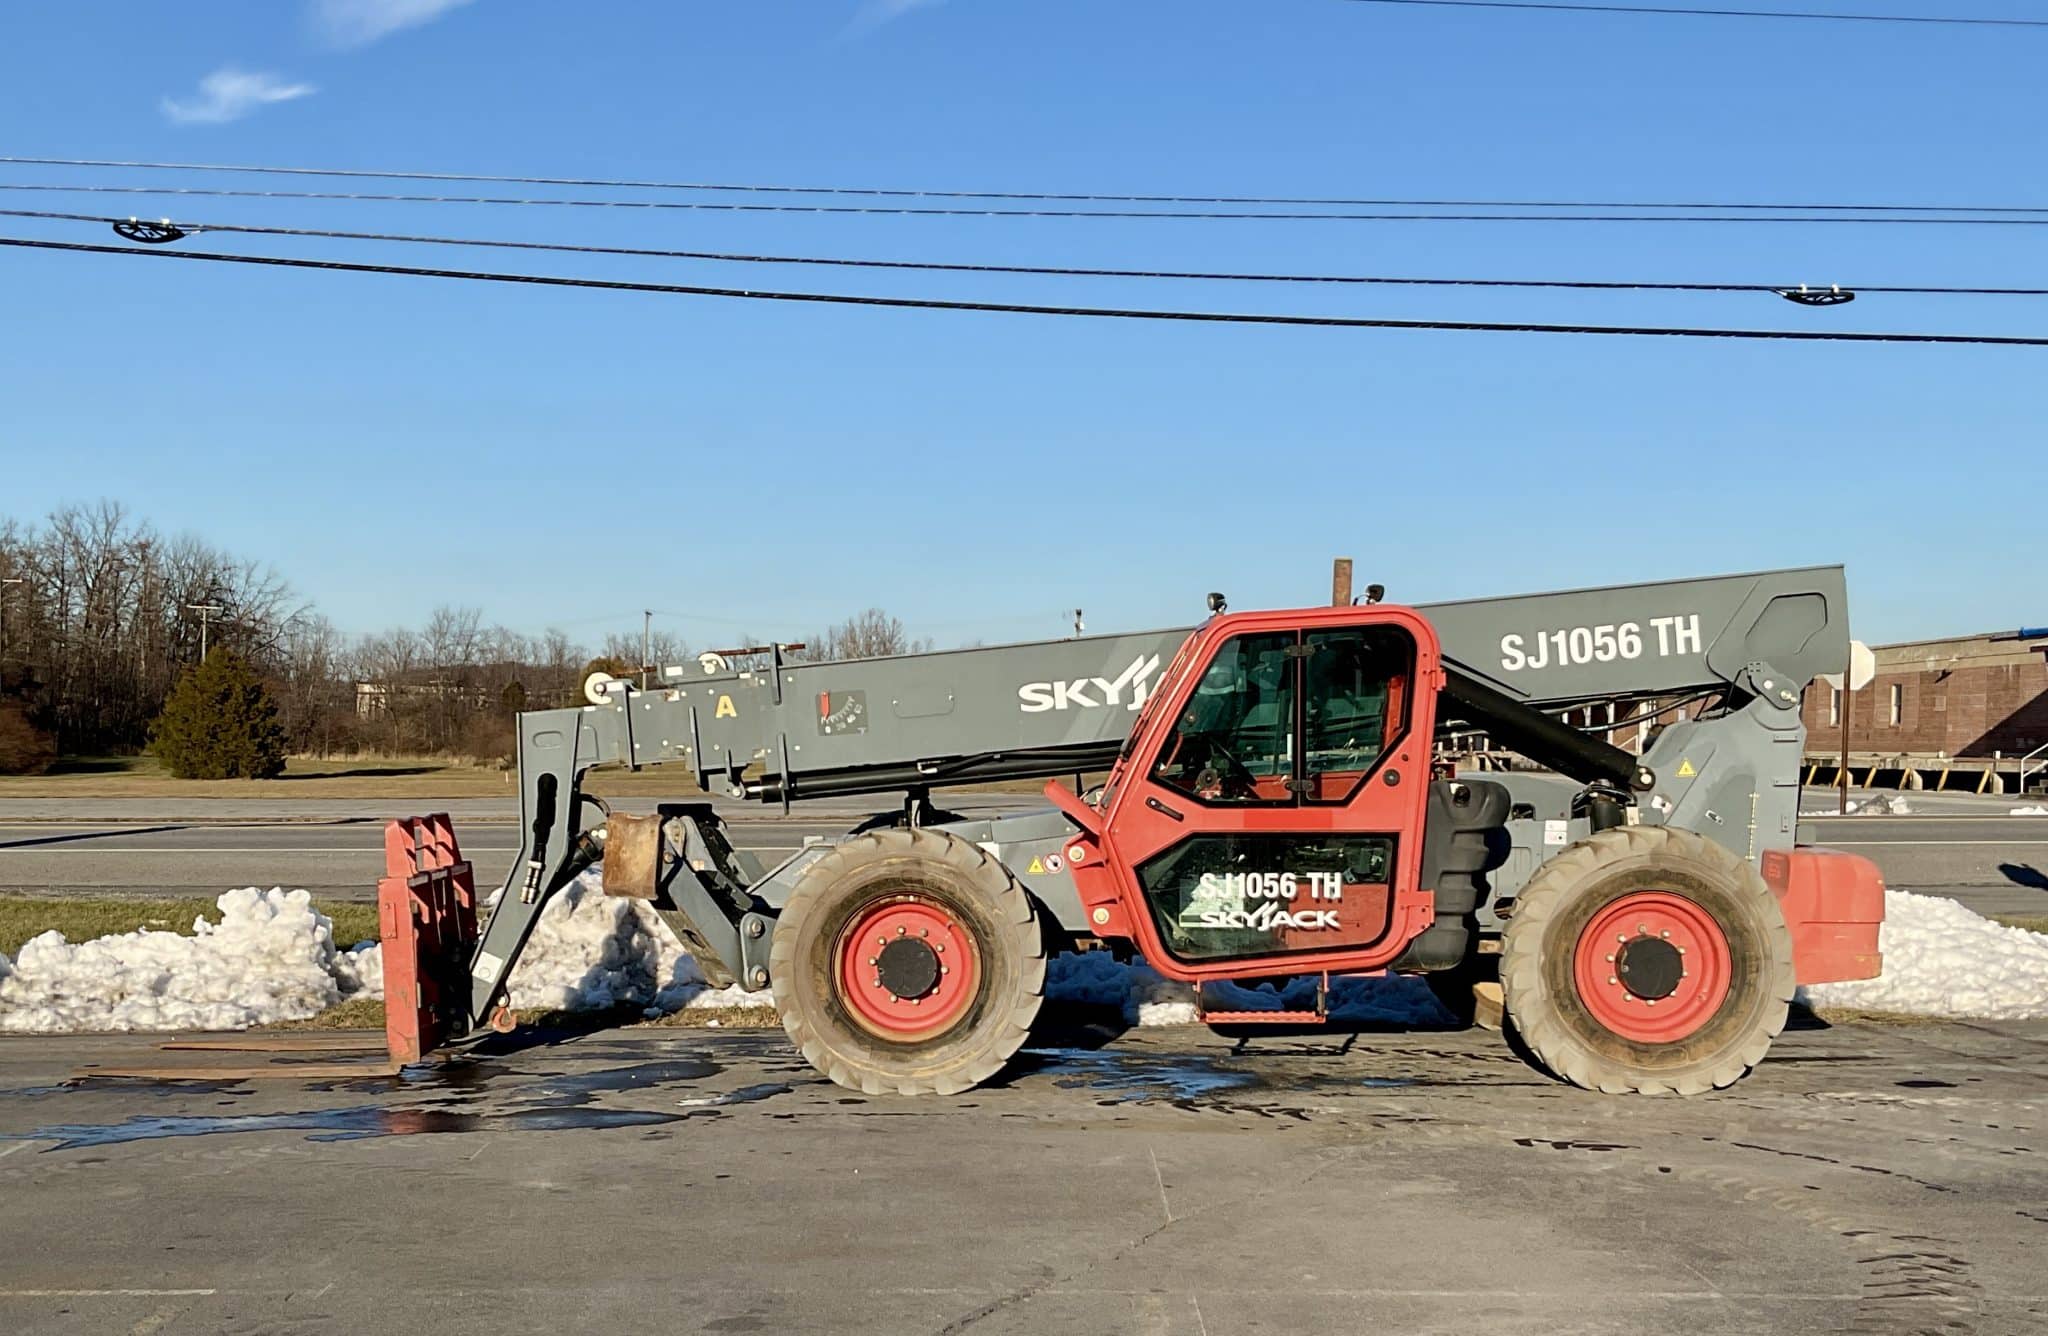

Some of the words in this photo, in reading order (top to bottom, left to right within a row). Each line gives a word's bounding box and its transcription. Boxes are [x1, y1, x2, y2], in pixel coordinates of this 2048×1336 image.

[1501, 622, 1642, 671] SJ1056
[1650, 614, 1701, 656] TH
[1017, 653, 1167, 712] SKYJ
[715, 695, 736, 718] A
[1200, 872, 1297, 899] SJ1056
[1307, 871, 1342, 899] TH
[1200, 901, 1342, 931] SKYJACK
